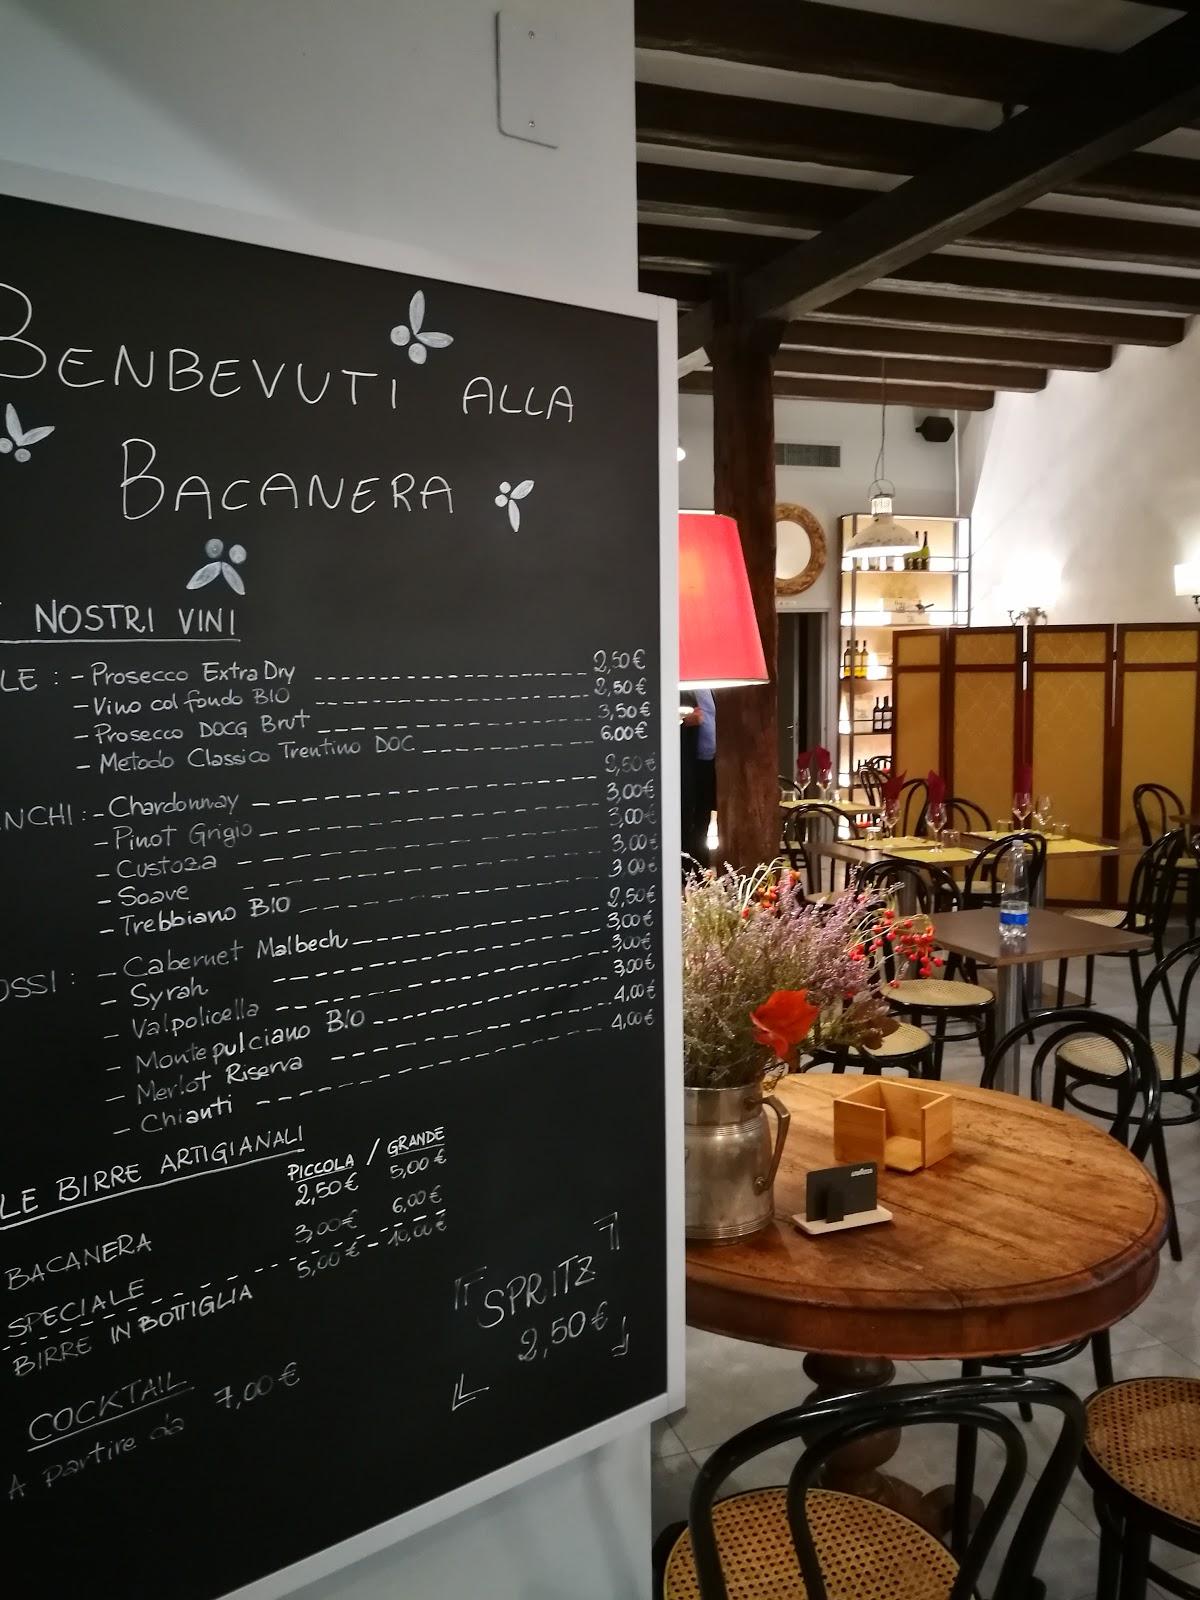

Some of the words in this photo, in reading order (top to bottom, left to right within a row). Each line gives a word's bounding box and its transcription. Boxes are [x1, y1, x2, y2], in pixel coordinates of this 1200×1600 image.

[462, 376, 574, 422] ALLA
[121, 438, 453, 519] BACANERA
[35, 599, 154, 634] NOSTRI
[178, 607, 235, 635] VINI
[91, 661, 189, 686] Prosecco
[202, 661, 258, 682] Extra
[264, 660, 295, 684] Dry
[94, 697, 142, 715] Vino
[150, 694, 179, 710] col
[184, 689, 243, 713] fondo
[252, 687, 290, 704] BIO
[94, 723, 184, 743] Prosecco
[199, 721, 248, 738] DOCG
[260, 708, 311, 732] Brut
[100, 749, 175, 774] Metodo
[187, 748, 270, 767] Classico
[277, 737, 361, 758] Trentino
[375, 735, 416, 753] DOC
[108, 791, 239, 817] Chardonnay
[113, 825, 178, 850] Pinot
[189, 820, 253, 848] Grigio
[116, 856, 217, 880] Custoza
[118, 886, 190, 906] Soave
[119, 906, 237, 936] Trebbiano
[248, 896, 291, 918] BIO
[123, 939, 244, 977] Cabernet
[257, 929, 349, 959] Malbech
[130, 977, 209, 1010] Syrah
[132, 998, 259, 1039] Valpolicella
[326, 1009, 366, 1033] BIO
[137, 1070, 212, 1104] Merlot
[225, 1056, 304, 1084] Riserva
[141, 1094, 233, 1134] Chianti
[0, 1188, 39, 1220] LE
[56, 1163, 142, 1201] BIRRE
[160, 1125, 304, 1175] ARTIGIANALI
[287, 1153, 355, 1182] PICCOLA
[386, 1126, 446, 1156] GRANDE
[5, 1232, 152, 1291] BACANERA
[8, 1278, 145, 1338] SPECIALE
[477, 1254, 596, 1329] SPRITZ
[13, 1336, 92, 1377] BIRRE
[111, 1322, 131, 1345] IN
[138, 1284, 253, 1334] BOTTIGLIA
[28, 1371, 187, 1441] COCKTAIL
[8, 1473, 26, 1500] A
[42, 1436, 137, 1488] partire
[150, 1412, 184, 1440] da
